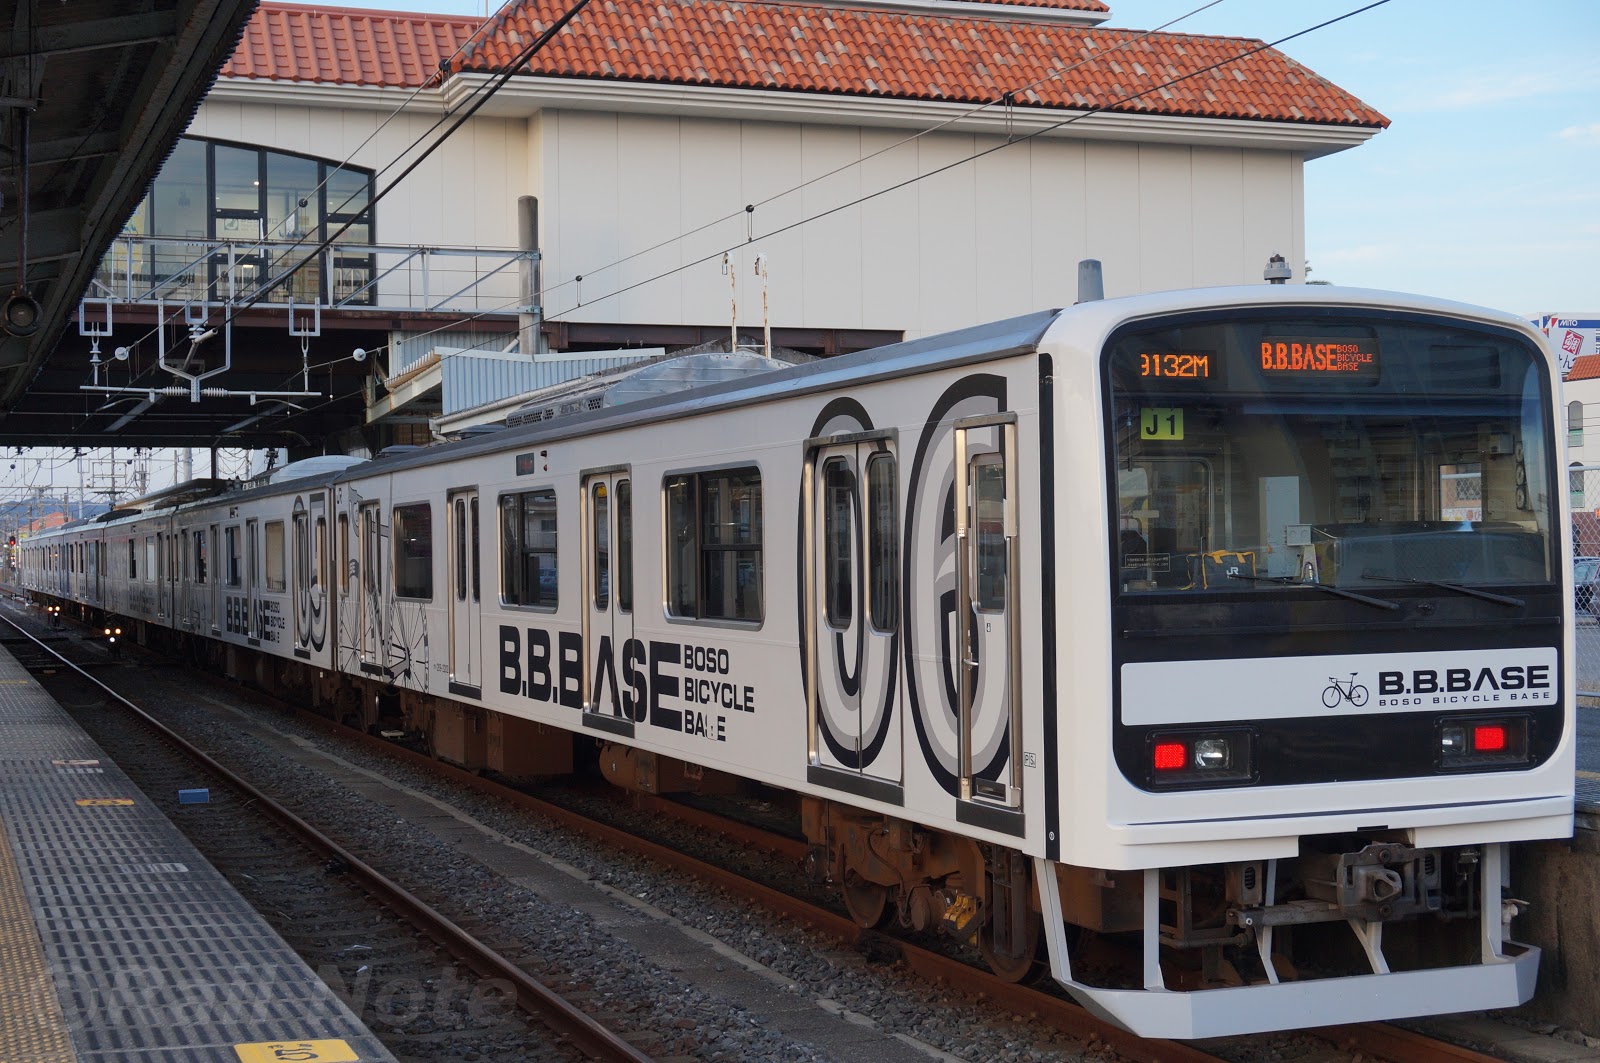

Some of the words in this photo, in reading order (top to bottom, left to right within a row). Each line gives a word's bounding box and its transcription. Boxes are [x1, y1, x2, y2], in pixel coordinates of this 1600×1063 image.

[1560, 319, 1578, 327] MITO
[1261, 342, 1338, 371] B.B.BASE
[1336, 345, 1358, 353] BOSO
[1337, 354, 1372, 362] BICYCLE
[1337, 362, 1359, 371] BASE
[1226, 566, 1239, 576] JR
[684, 644, 729, 675] BOSO
[499, 625, 682, 732] B.B.BASE
[1378, 665, 1550, 696] B.B.BASE
[684, 676, 755, 713] BICYCLE
[1379, 698, 1422, 706] BOSO
[1432, 694, 1500, 704] BICYCLE
[1510, 691, 1550, 701] BASE
[684, 709, 726, 742] BAE
